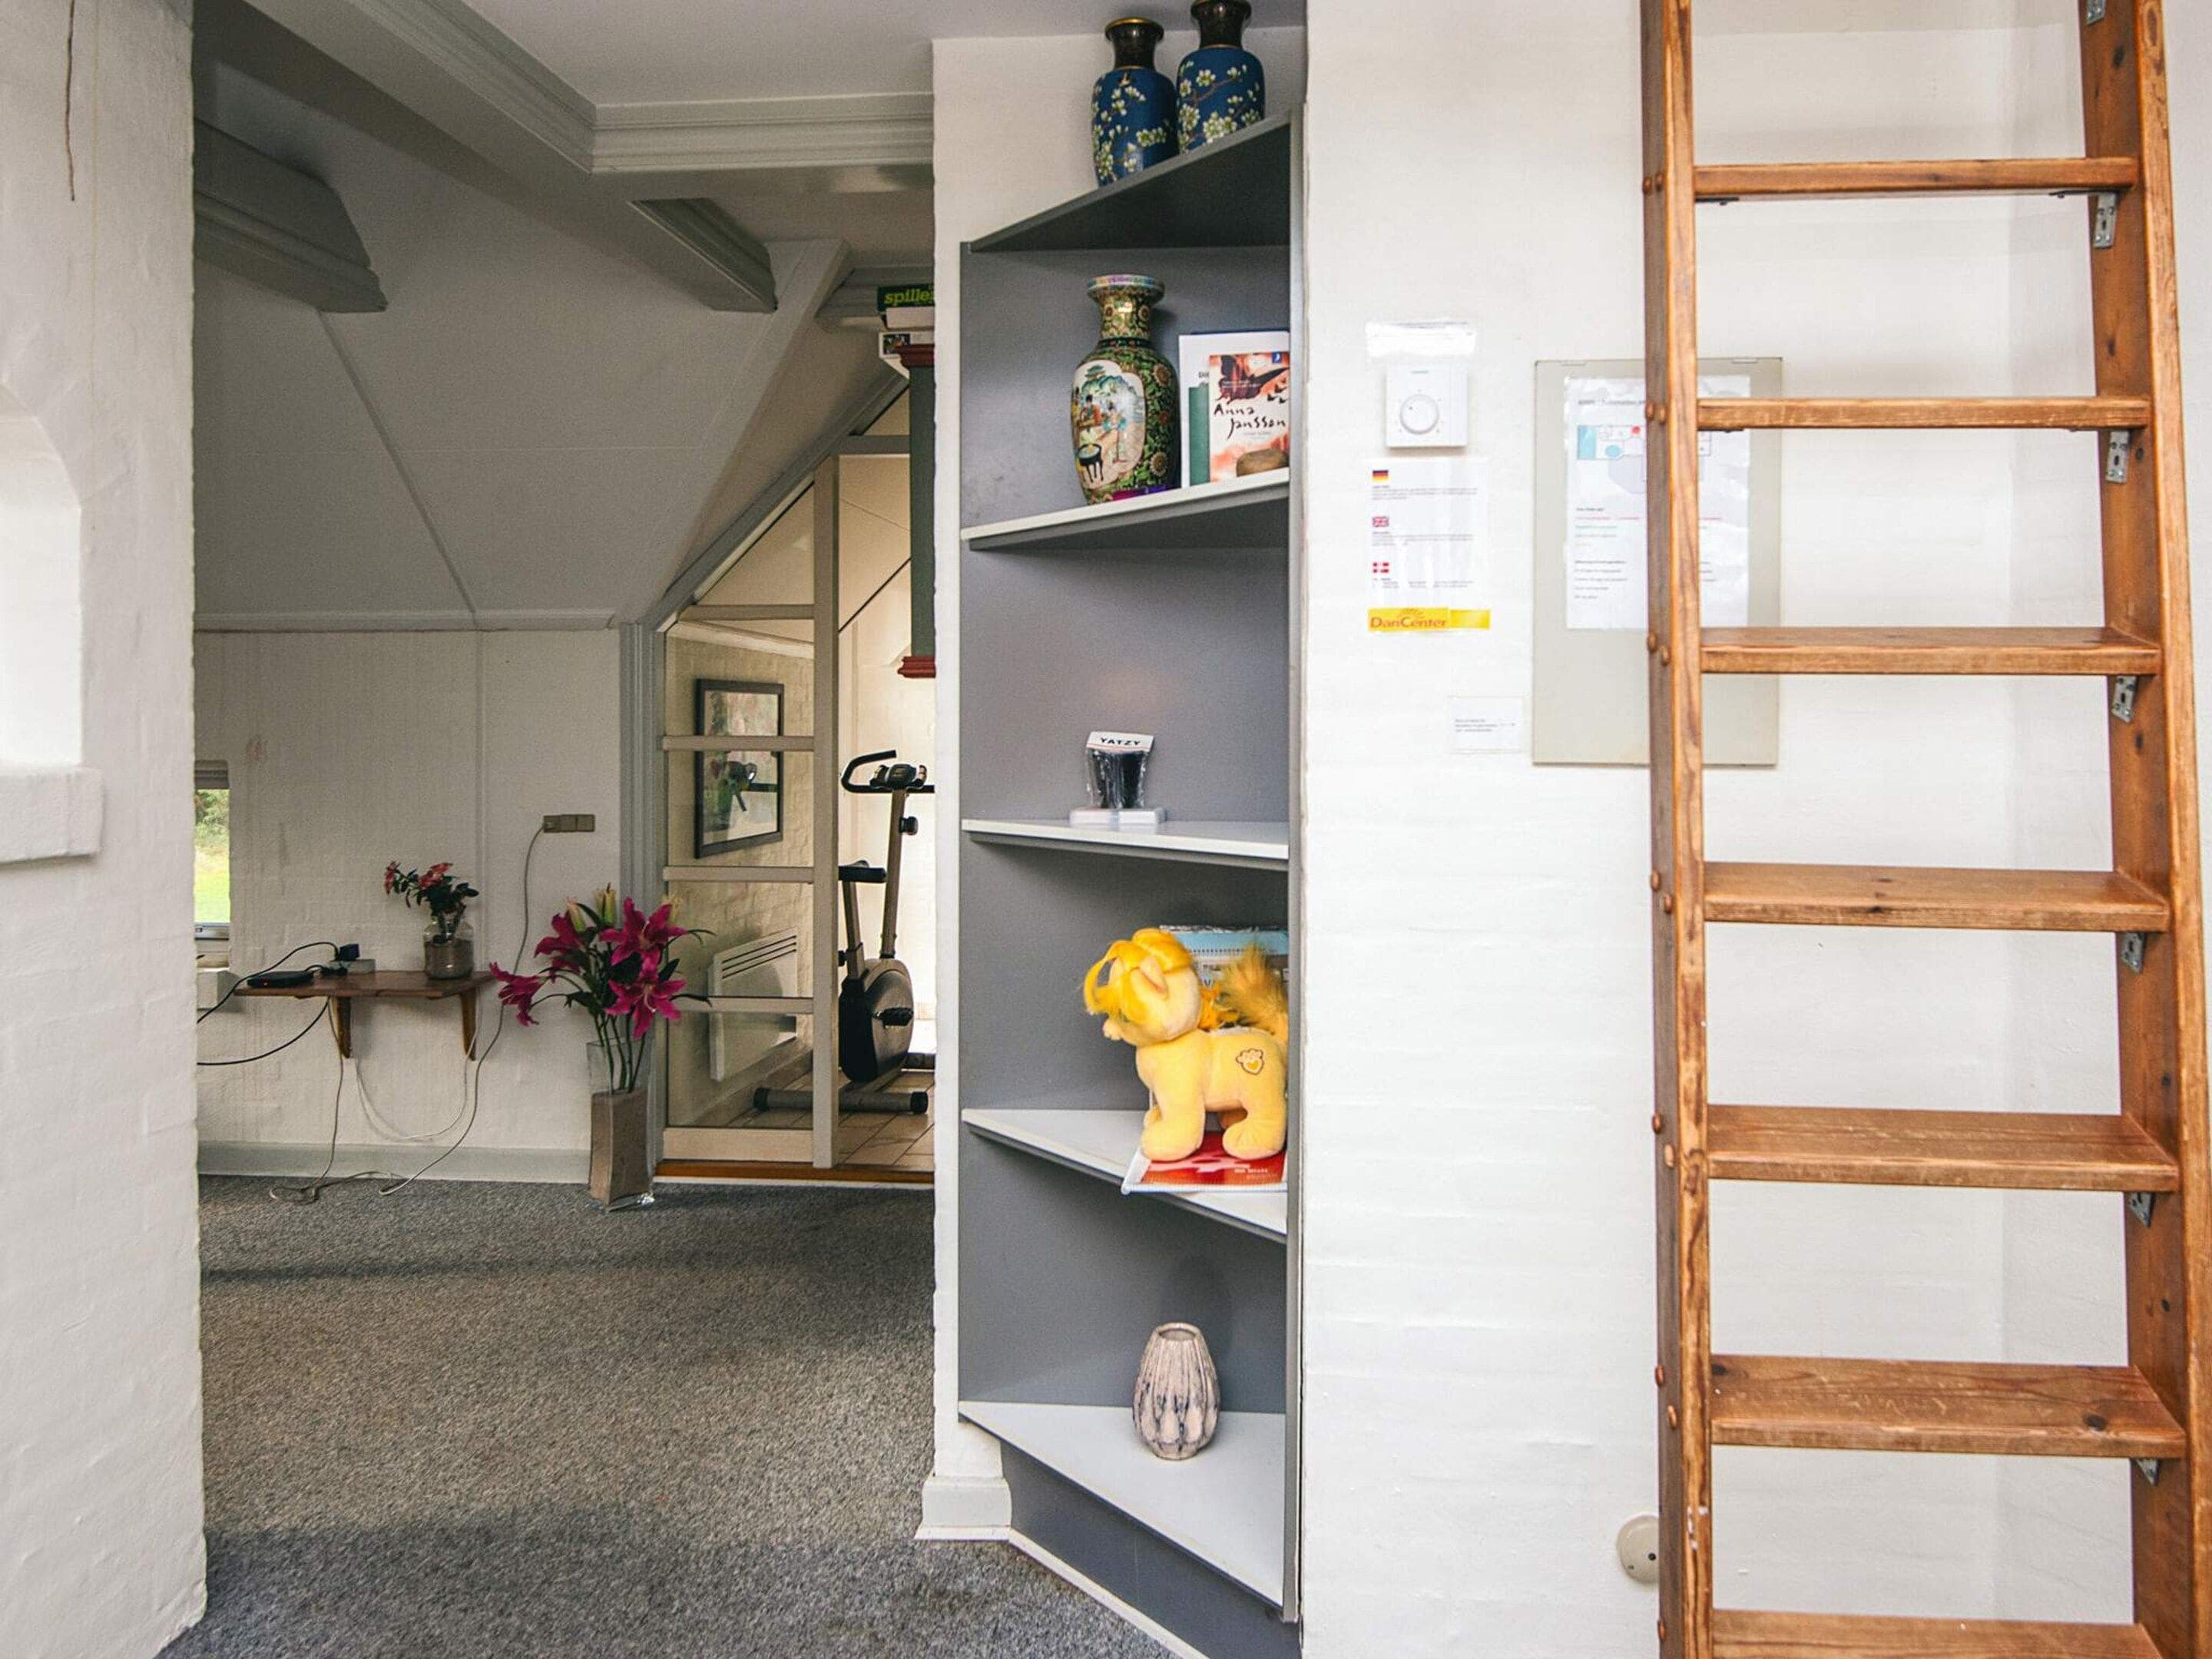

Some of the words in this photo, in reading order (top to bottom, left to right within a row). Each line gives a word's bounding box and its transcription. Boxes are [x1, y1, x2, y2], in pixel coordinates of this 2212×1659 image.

[1214, 403, 1255, 416] Anna
[1370, 616, 1447, 628] DanCenter
[1100, 737, 1141, 746] YATZY
